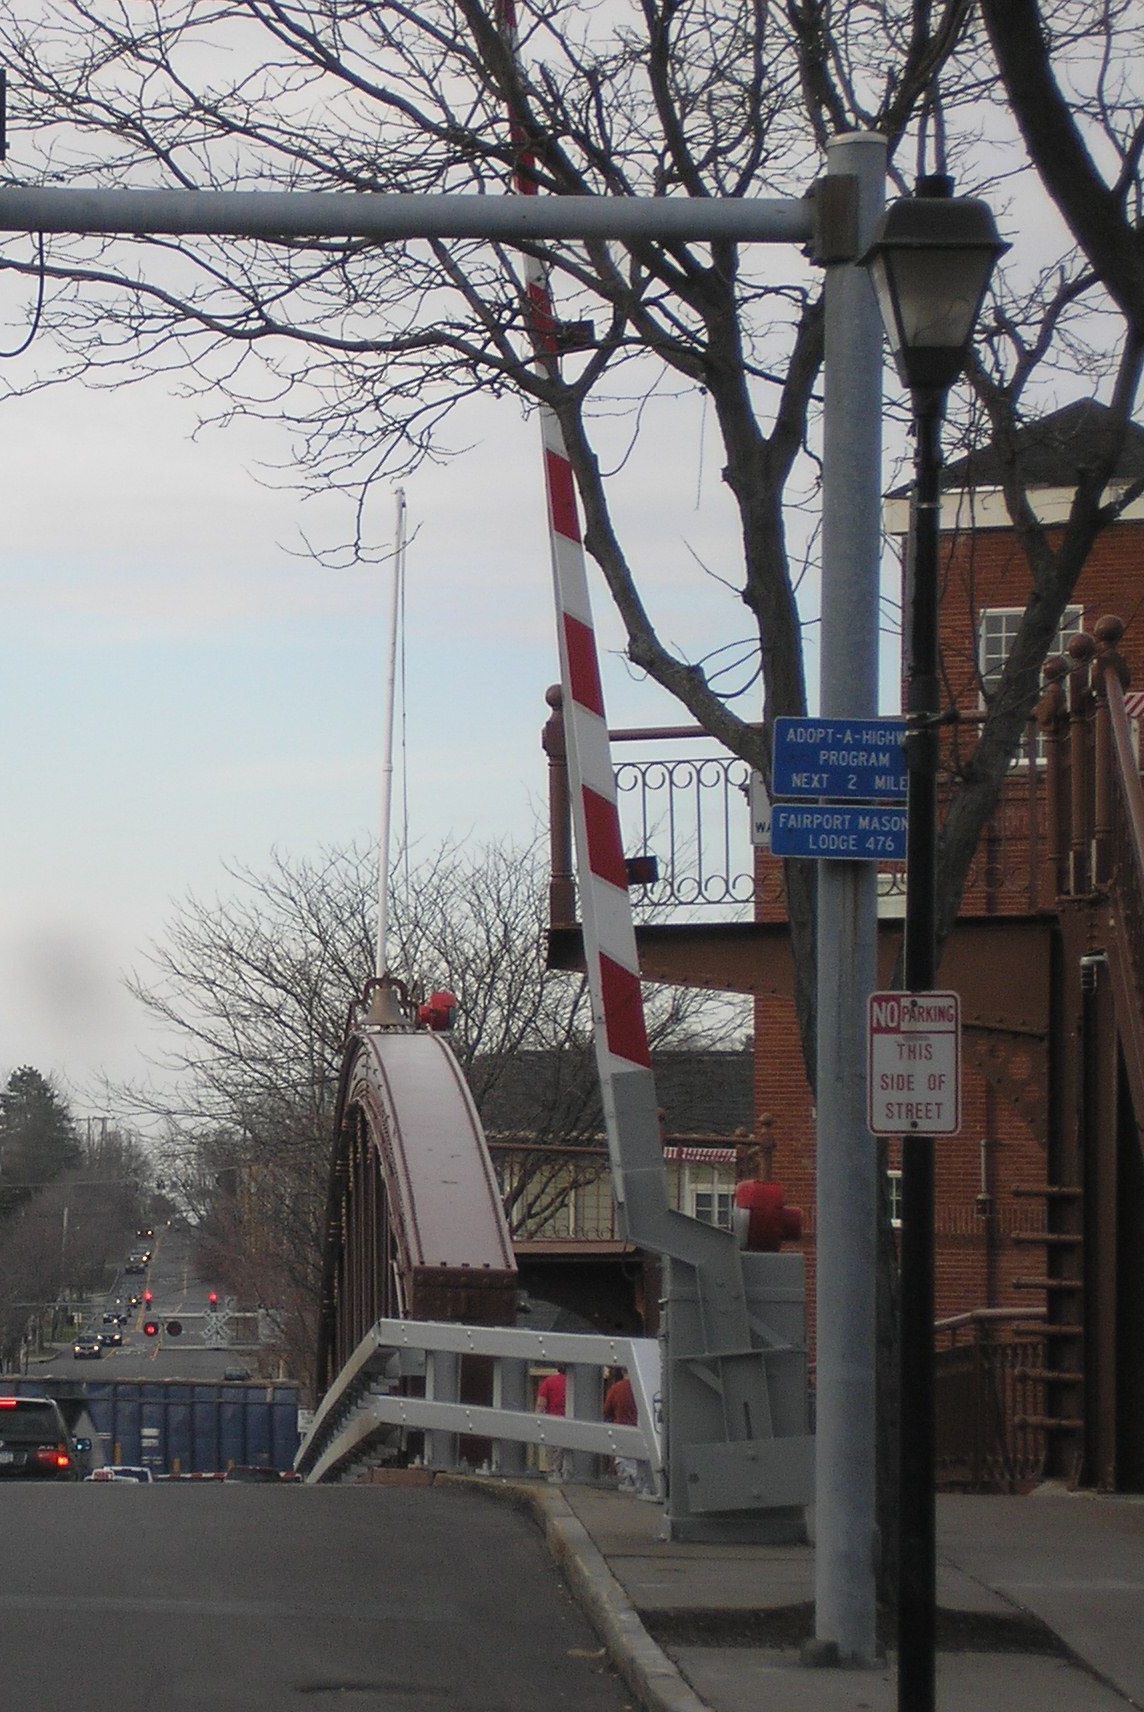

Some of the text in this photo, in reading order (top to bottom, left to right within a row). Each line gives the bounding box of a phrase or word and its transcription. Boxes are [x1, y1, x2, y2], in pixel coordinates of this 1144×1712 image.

[819, 751, 890, 767] PROGRAM
[792, 773, 829, 789] NEXT
[848, 775, 856, 790] 2
[779, 813, 851, 830] FAIRPORT
[809, 834, 894, 851] LODGE 476
[872, 1001, 954, 1028] NO PARKING
[897, 1043, 933, 1061] THIS
[880, 1073, 946, 1091] SIDE OF
[885, 1102, 943, 1120] STREET
